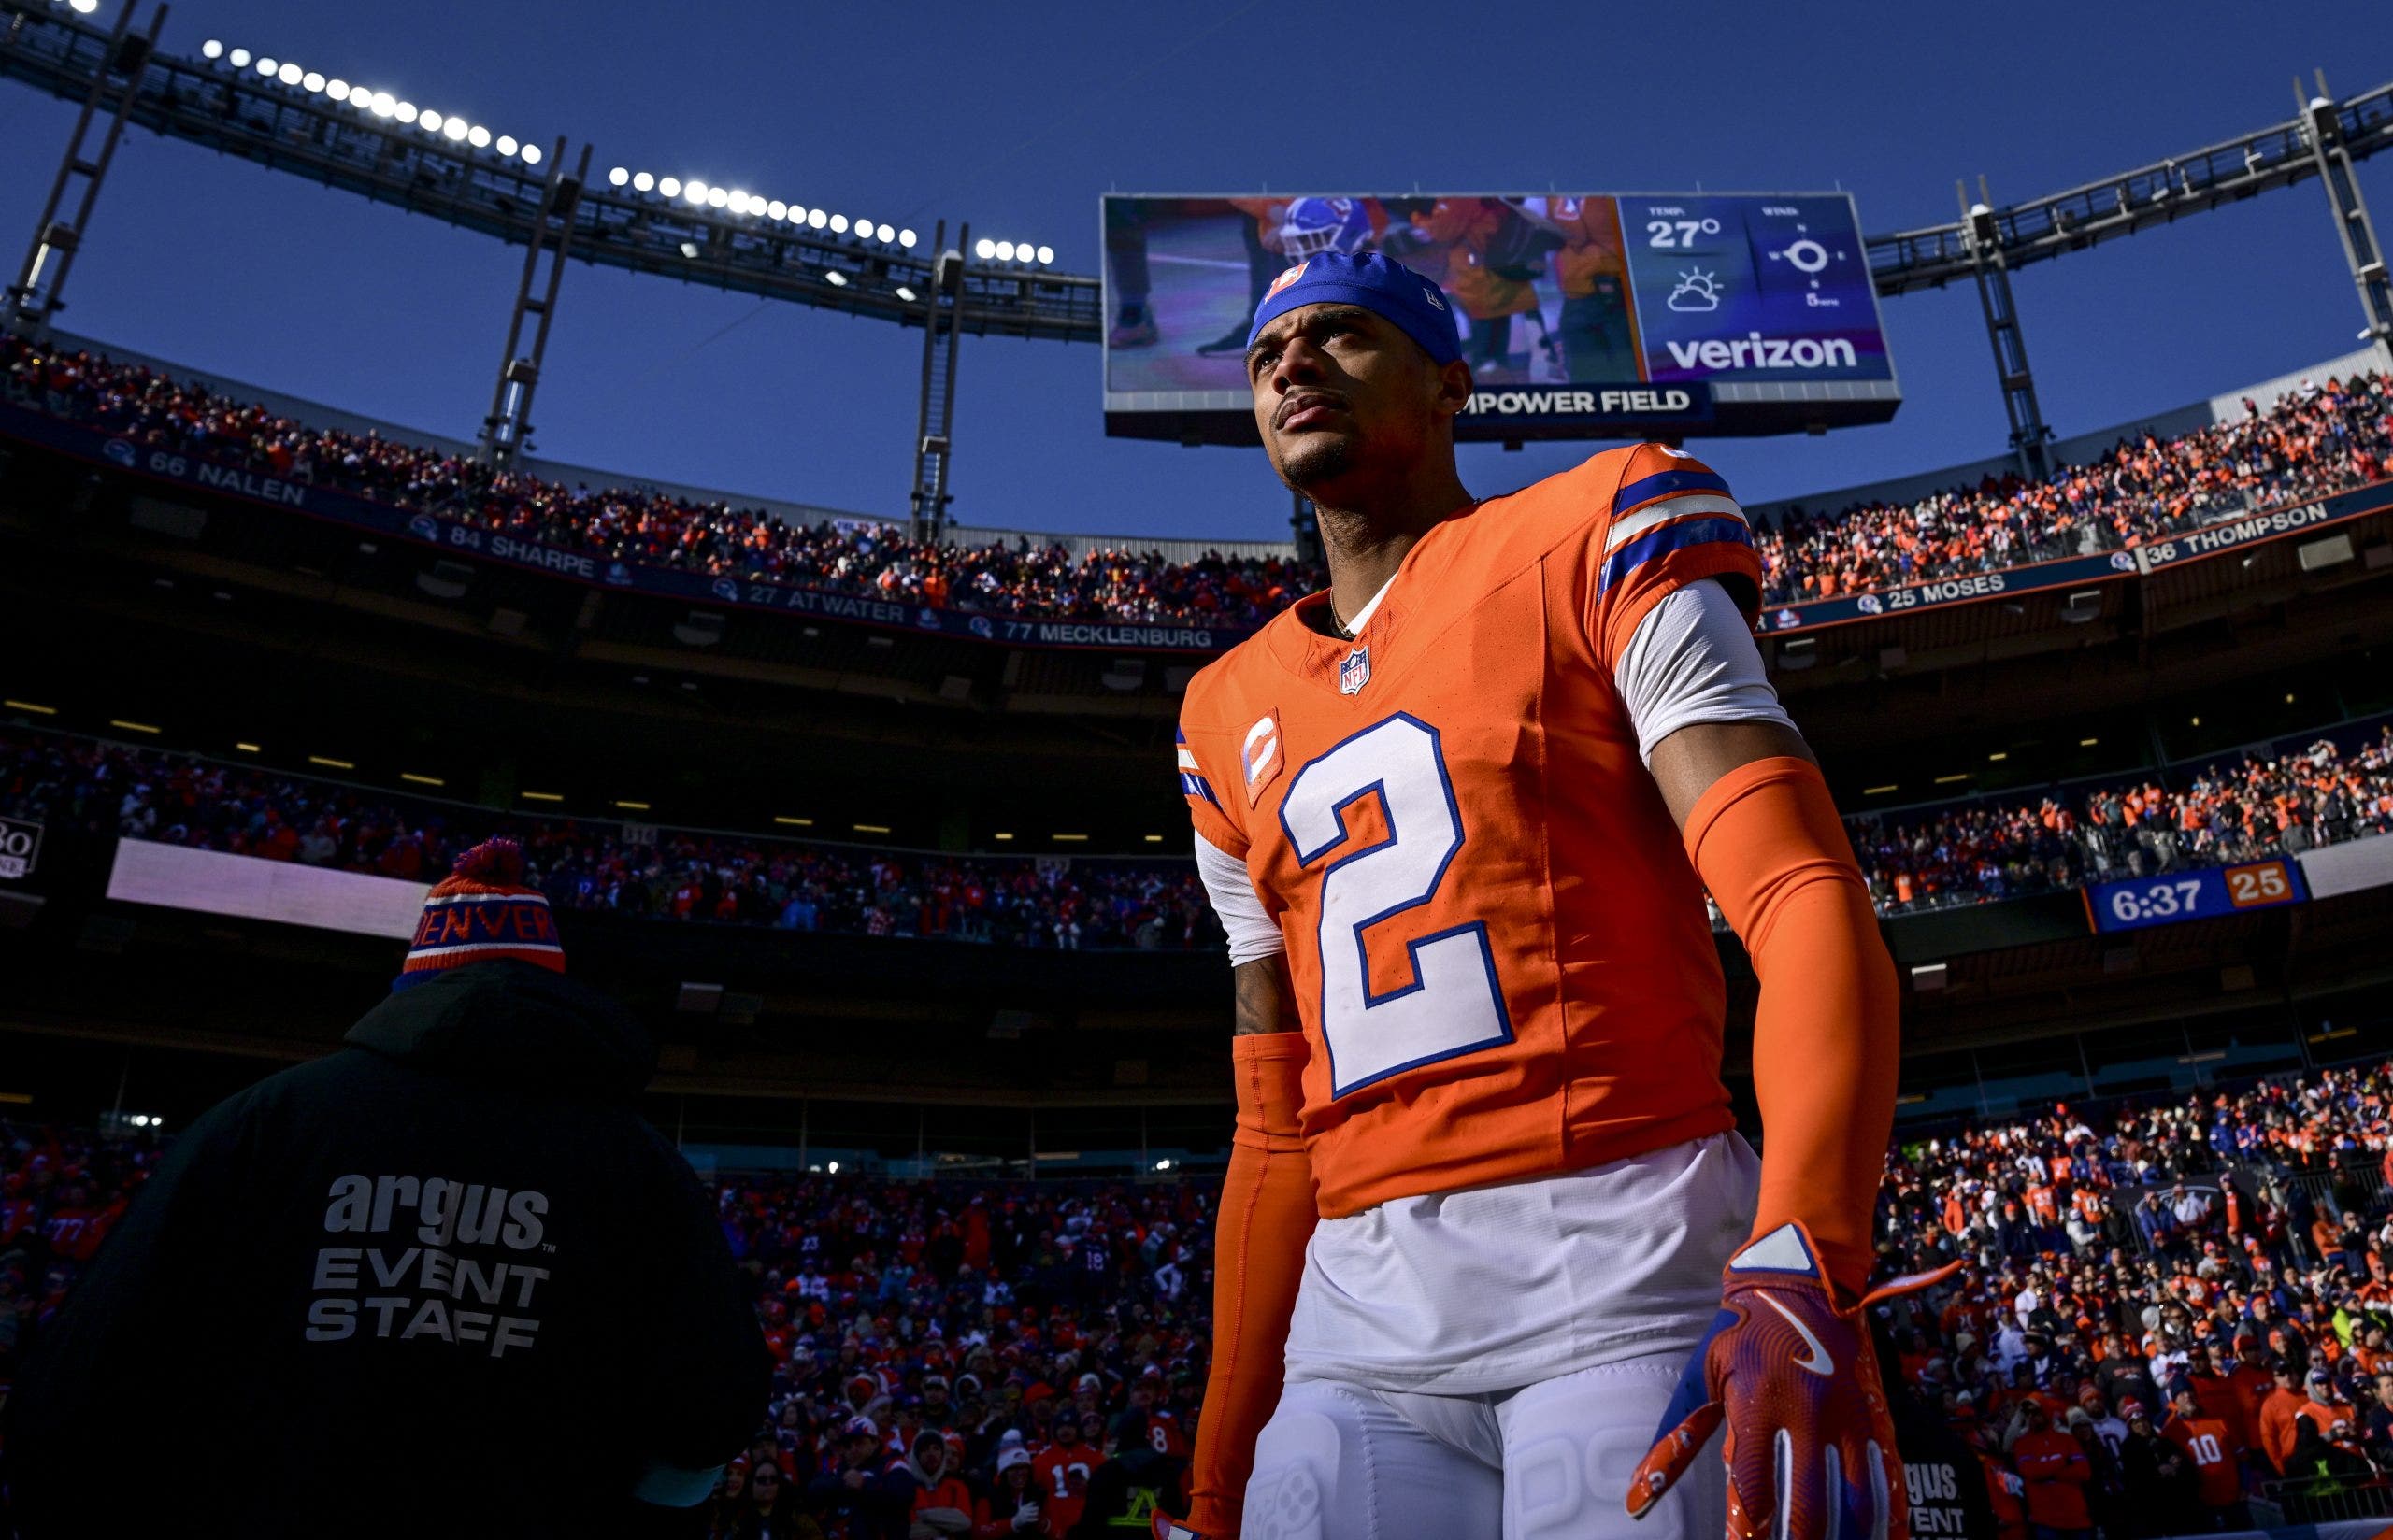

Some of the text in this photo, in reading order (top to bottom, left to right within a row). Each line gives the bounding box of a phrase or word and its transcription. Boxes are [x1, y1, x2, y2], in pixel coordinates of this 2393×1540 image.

[1666, 331, 1858, 370] verizon
[1600, 389, 1691, 413] FIELD
[149, 451, 308, 507] 66 NALEN
[449, 525, 482, 549] 84
[490, 534, 596, 579] SHARPE
[2147, 501, 2329, 564] 36 THOMPSON
[749, 585, 778, 606] 27
[1887, 573, 2007, 609] 25 MOSES
[1003, 620, 1213, 649] 77 MECKLENBURG
[1344, 665, 1366, 688] NFL
[2112, 880, 2201, 921] 6:37
[2232, 868, 2286, 901] 25
[1279, 710, 1516, 1102] 2
[324, 1174, 550, 1250] argus
[312, 1248, 552, 1308] EVENT
[304, 1296, 541, 1358] STAFF
[1151, 1425, 1168, 1454] 8
[2188, 1433, 2223, 1466] 10
